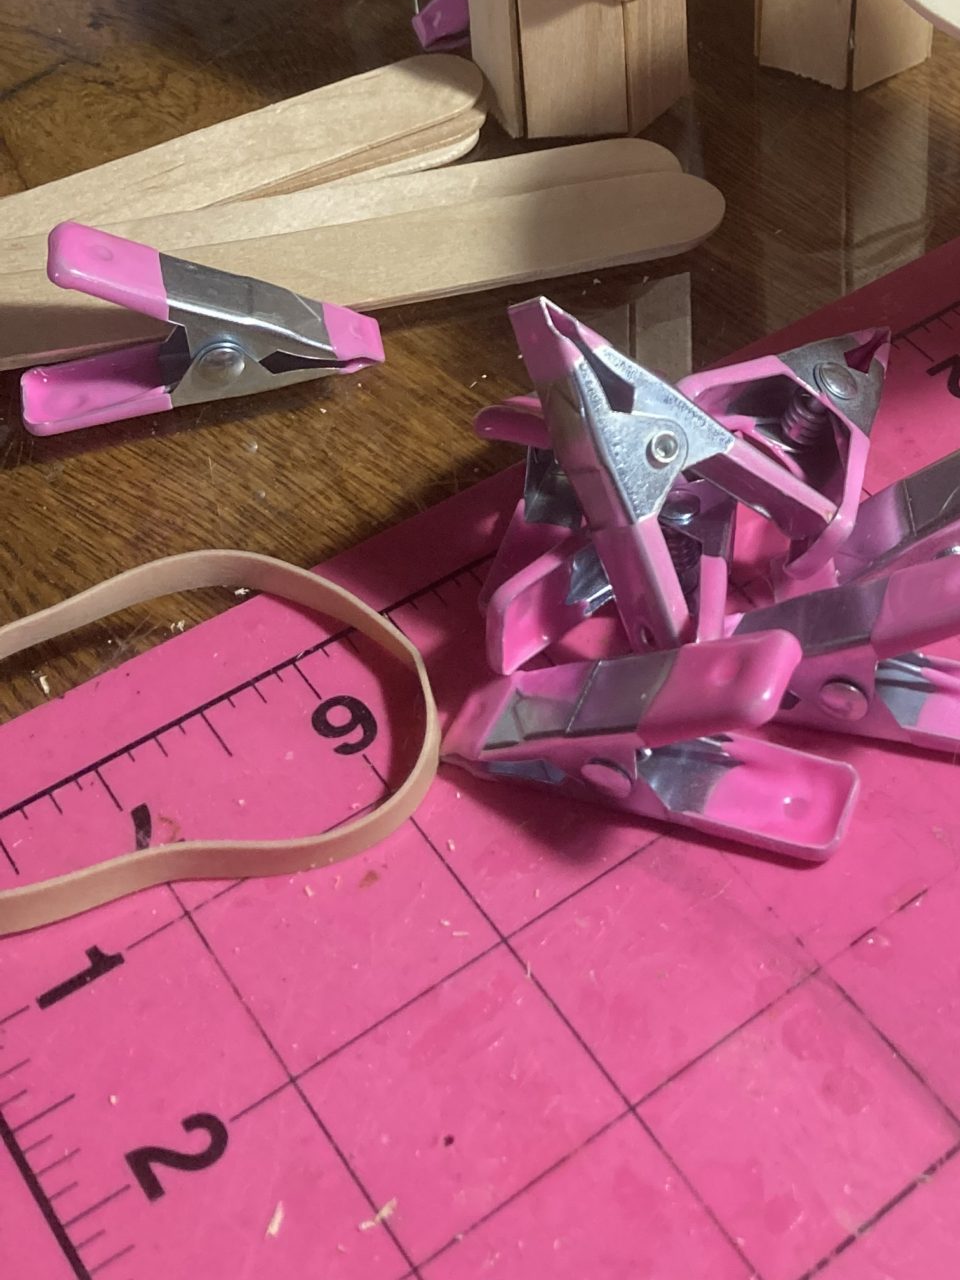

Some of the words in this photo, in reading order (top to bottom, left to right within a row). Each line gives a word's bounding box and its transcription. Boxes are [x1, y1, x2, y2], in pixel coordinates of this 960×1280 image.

[310, 694, 379, 756] 6
[35, 944, 126, 1011] 1
[124, 1111, 230, 1202] 2
